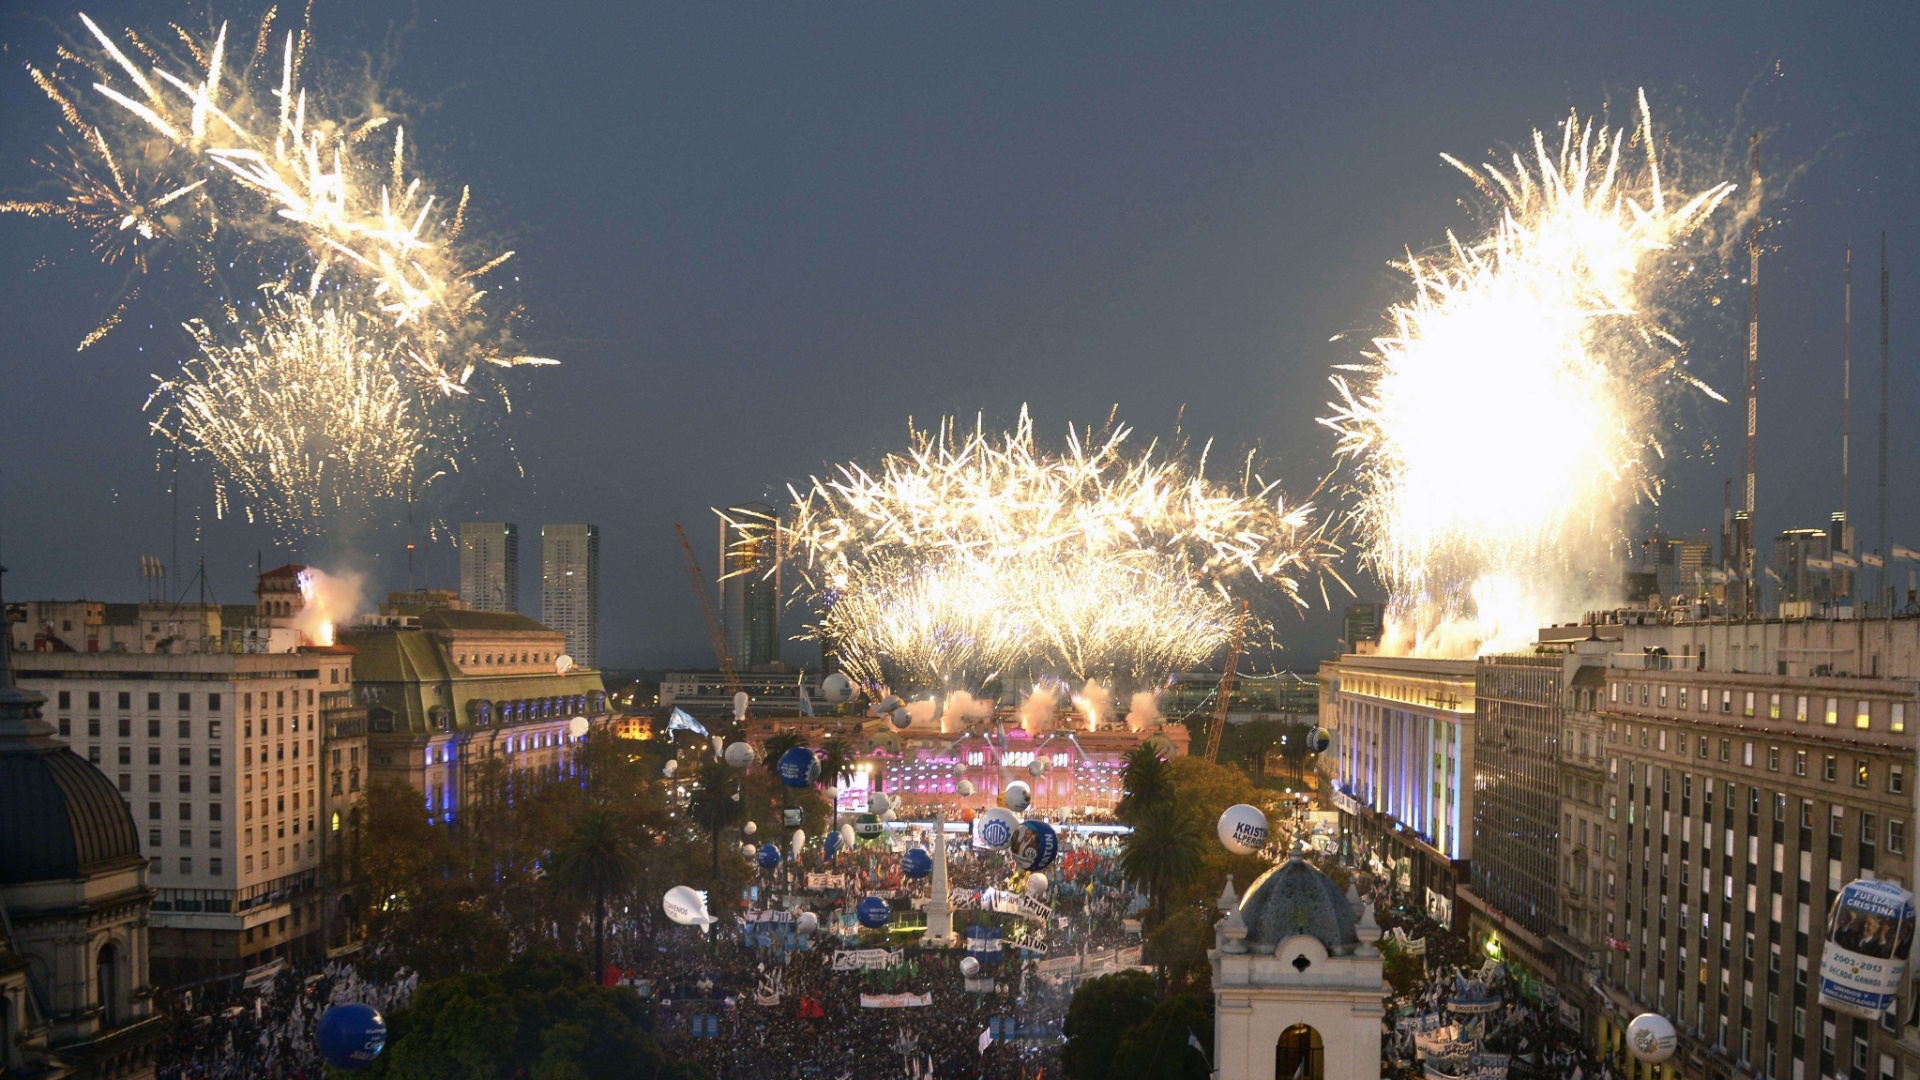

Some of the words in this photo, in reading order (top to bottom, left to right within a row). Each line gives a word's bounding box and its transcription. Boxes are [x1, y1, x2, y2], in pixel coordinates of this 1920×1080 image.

[1037, 833, 1054, 868] FATUN
[1023, 895, 1051, 921] FATUN
[1846, 898, 1896, 918] CRISTINA
[1016, 937, 1048, 952] FATUN
[1824, 988, 1877, 1007] ORGANIZADOS
[1833, 985, 1862, 998] UNIDOS
